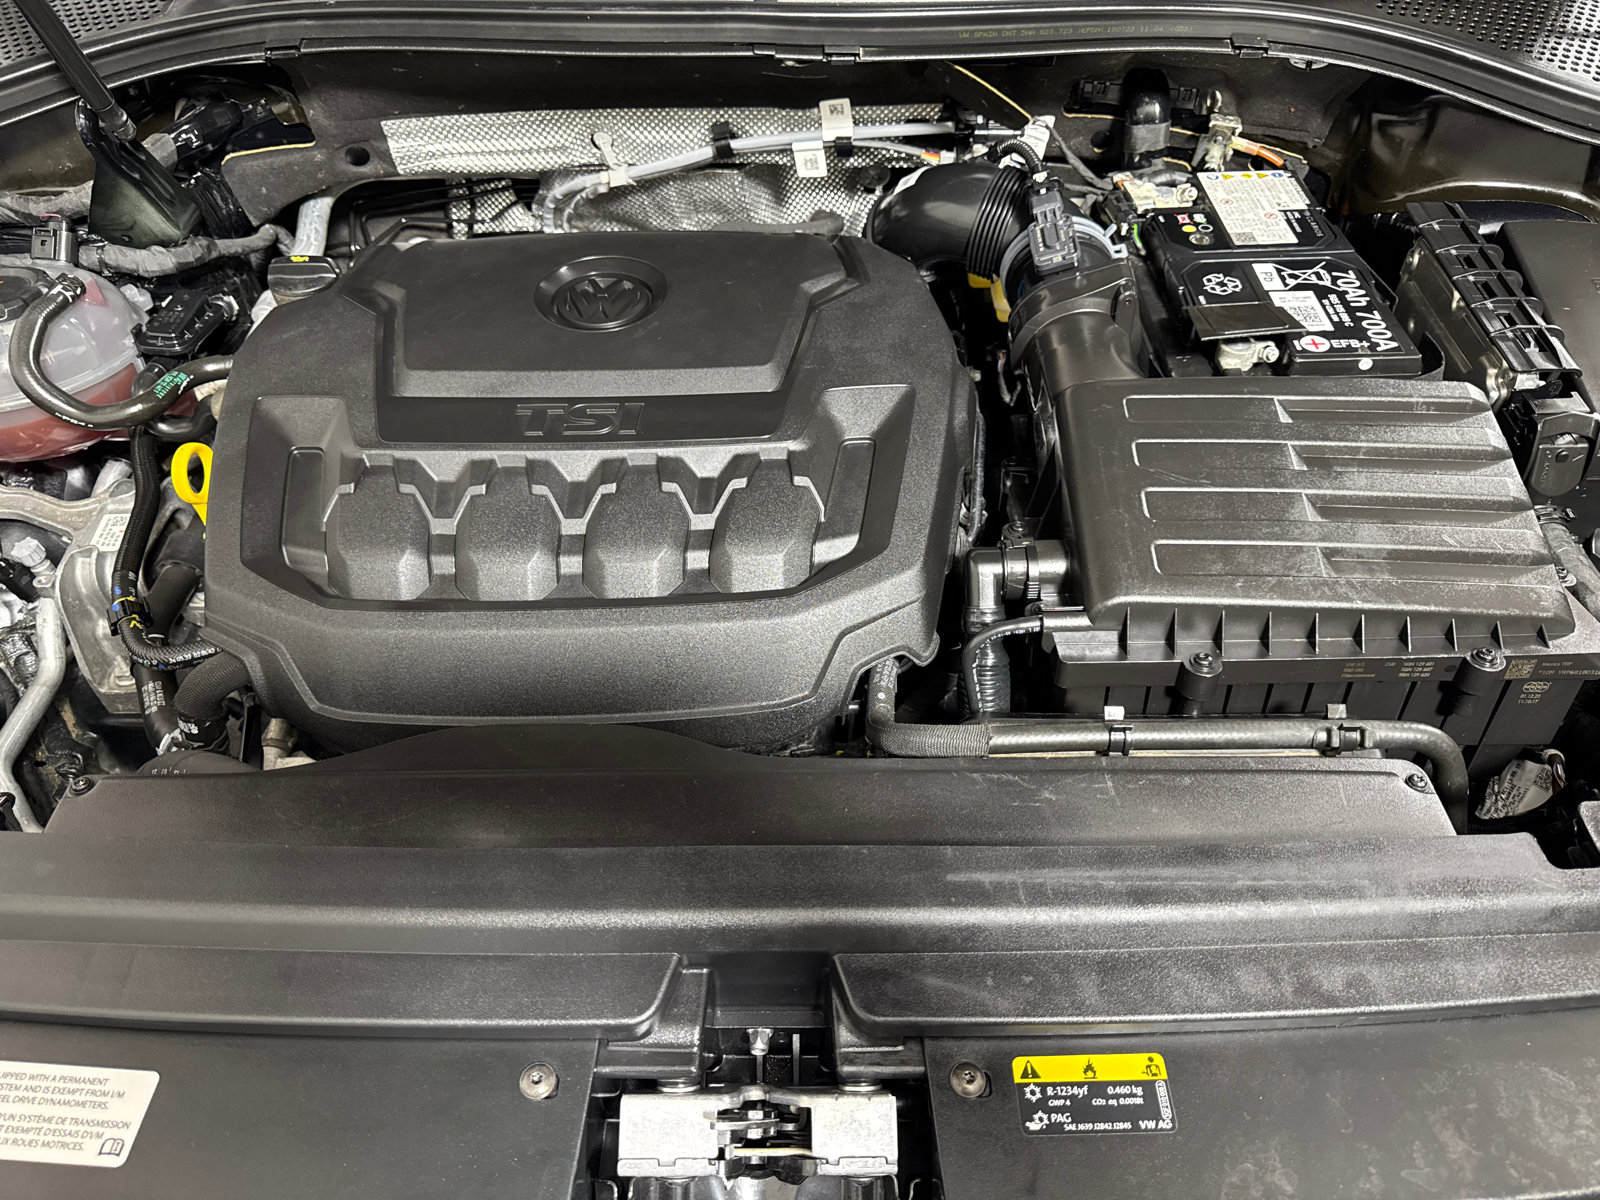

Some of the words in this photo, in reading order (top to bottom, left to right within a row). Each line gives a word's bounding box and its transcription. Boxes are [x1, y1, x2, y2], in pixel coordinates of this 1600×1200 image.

[1306, 216, 1324, 237] CLARIOS
[1260, 271, 1273, 282] Pb
[1331, 270, 1371, 307] 70Ah
[1355, 310, 1399, 352] 700A
[515, 403, 645, 436] TSI
[28, 1073, 51, 1082] WITH
[50, 1075, 57, 1083] A
[58, 1075, 111, 1086] PERMANENT
[22, 1084, 43, 1093] AND
[42, 1086, 52, 1094] IS
[51, 1086, 86, 1096] EXEMPT
[84, 1088, 111, 1098] FROM
[110, 1090, 126, 1099] I/M
[1046, 1084, 1089, 1099] R-1234yf
[1107, 1085, 1131, 1095] 0.460
[1131, 1084, 1144, 1096] kg
[12, 1095, 39, 1105] DRIVE
[37, 1097, 109, 1110] DYNAMOMETERS.
[1048, 1099, 1065, 1107] GWP
[1107, 1099, 1118, 1107] eq
[17, 1113, 56, 1125] SYSTÈME
[55, 1116, 69, 1126] DE
[68, 1117, 132, 1130] TRANSMISSION
[1050, 1112, 1072, 1123] PAG
[4, 1125, 44, 1136] EXEMPTÉ
[43, 1127, 81, 1138] D'ESSAIS
[1063, 1123, 1077, 1131] SAE
[1077, 1122, 1094, 1131] J639
[1093, 1122, 1113, 1131] J2842
[1113, 1121, 1133, 1130] J2845
[1138, 1120, 1156, 1130] VW
[1157, 1119, 1173, 1130] AG
[10, 1137, 41, 1148] ROUES
[40, 1139, 85, 1151] MOTRICES.
